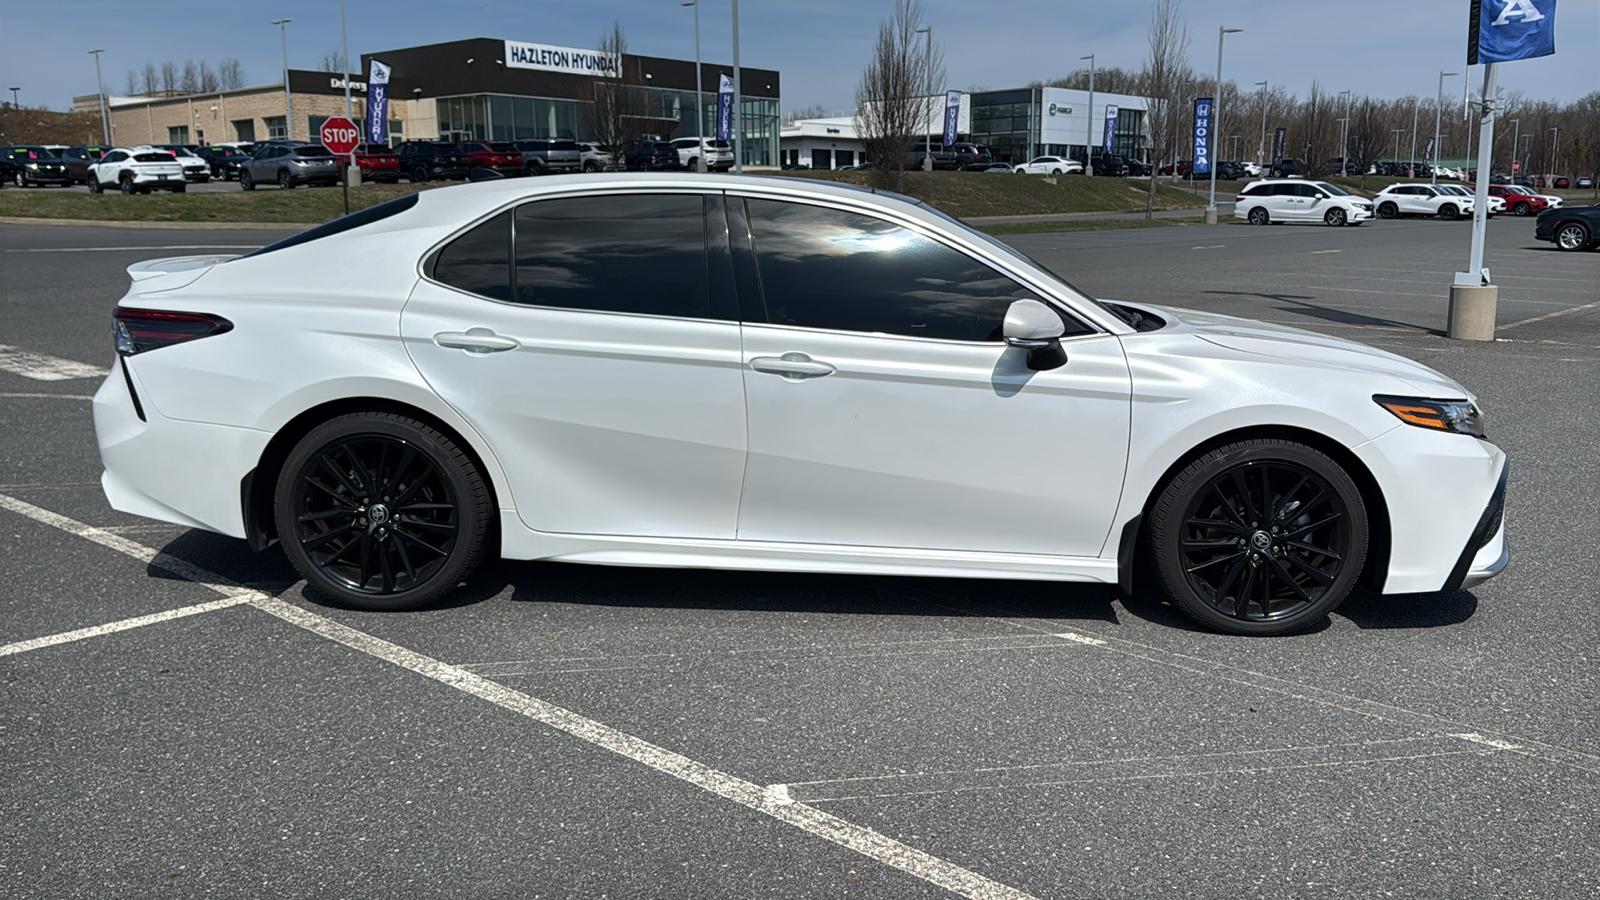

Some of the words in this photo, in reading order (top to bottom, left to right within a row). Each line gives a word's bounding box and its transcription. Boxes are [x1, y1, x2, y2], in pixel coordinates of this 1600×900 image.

[511, 46, 569, 67] HAZLETON
[330, 78, 367, 92] Delvery
[372, 86, 384, 141] HYUNDAI
[323, 128, 357, 143] STOP
[1196, 119, 1208, 164] HONDA
